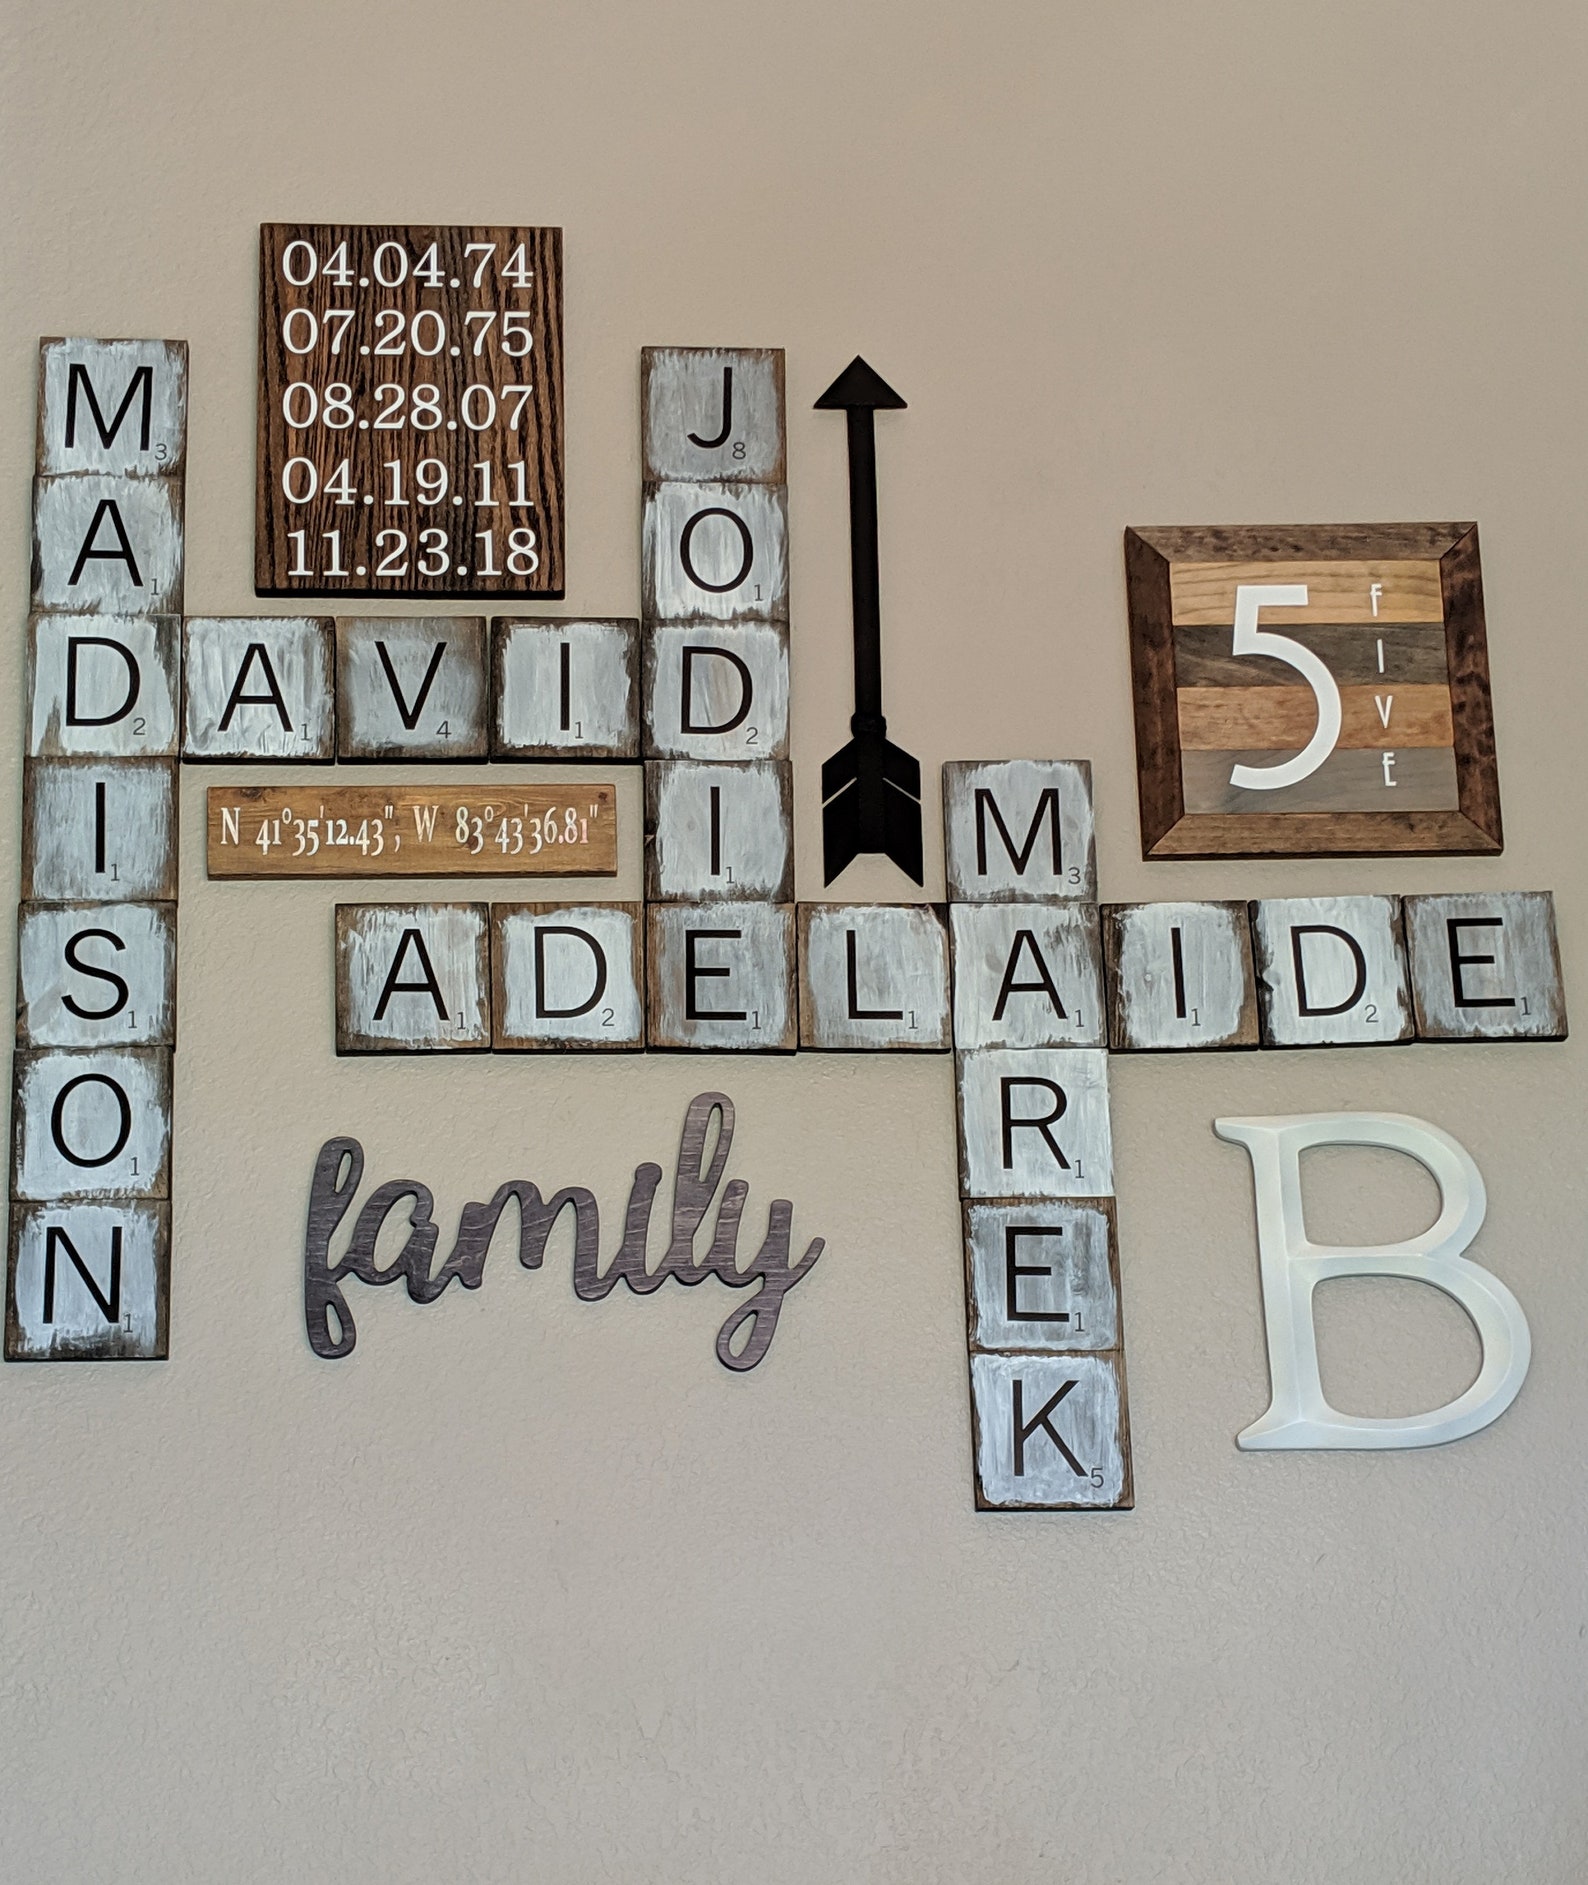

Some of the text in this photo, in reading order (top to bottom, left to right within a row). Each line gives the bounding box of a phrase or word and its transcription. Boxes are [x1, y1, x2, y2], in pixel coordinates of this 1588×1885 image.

[282, 241, 534, 288] 04.04.74
[282, 308, 533, 357] 07.20.75
[282, 381, 533, 430] 08.28.07
[154, 443, 167, 461] 3
[732, 442, 746, 460] 8
[282, 457, 535, 506] 04.19.11
[287, 529, 539, 577] 11.23.18
[150, 578, 160, 596] 1
[754, 584, 764, 601] 1
[1229, 584, 1342, 790] 5
[1371, 583, 1397, 787] FIVE
[132, 718, 146, 736] 2
[300, 724, 310, 741] 1
[436, 721, 451, 739] 4
[574, 721, 584, 739] 1
[746, 727, 759, 744] 2
[220, 807, 240, 845] N
[413, 805, 439, 843] W
[110, 864, 120, 881] 1
[725, 867, 735, 884] 1
[1068, 867, 1081, 884] 3
[1365, 1005, 1377, 1023] 2
[1521, 998, 1531, 1016] 1
[127, 1011, 137, 1029] 1
[456, 1013, 467, 1030] 1
[601, 1009, 615, 1027] 2
[751, 1011, 762, 1029] 1
[908, 1011, 918, 1029] 1
[1075, 1010, 1084, 1027] 1
[1191, 1009, 1200, 1026] 1
[129, 1157, 140, 1175] 1
[1074, 1160, 1084, 1179] 1
[305, 1091, 825, 1371] family
[1214, 1111, 1532, 1451] B
[123, 1313, 133, 1333] 1
[1074, 1313, 1085, 1332] 1
[1090, 1469, 1104, 1488] 5
